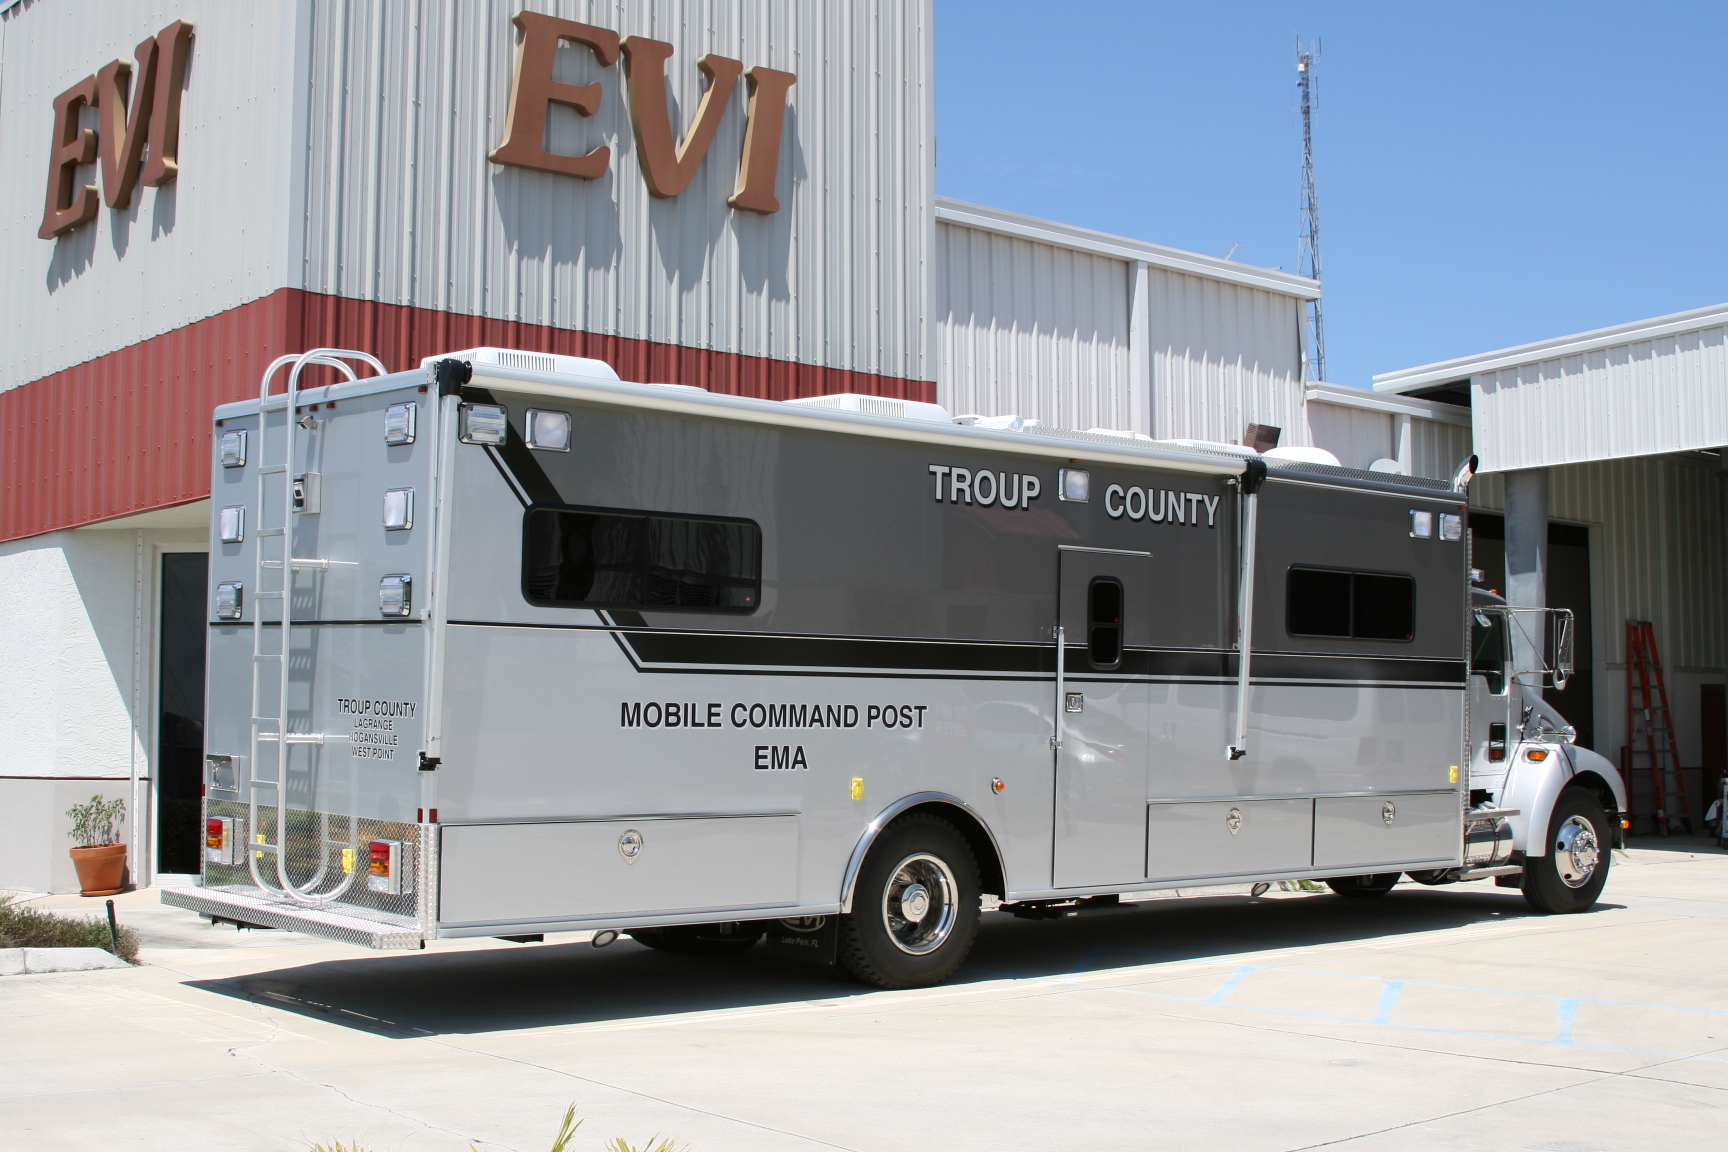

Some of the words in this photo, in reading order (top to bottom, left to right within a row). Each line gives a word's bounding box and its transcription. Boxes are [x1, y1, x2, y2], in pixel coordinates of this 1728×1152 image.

[489, 10, 797, 215] EVI
[38, 19, 194, 240] EVI
[929, 463, 1041, 510] TROUP
[1105, 482, 1220, 528] COUNTY
[337, 698, 371, 715] TROUP
[373, 700, 416, 718] COUNTY
[620, 701, 723, 729] MOBILE
[730, 702, 860, 729] COMMAND
[866, 704, 928, 729] POST
[354, 718, 393, 731] LAGRANGE
[348, 731, 398, 746] HOGANSVILLE
[351, 746, 371, 758] WEST
[372, 747, 395, 761] POINT
[754, 745, 809, 771] EMA
